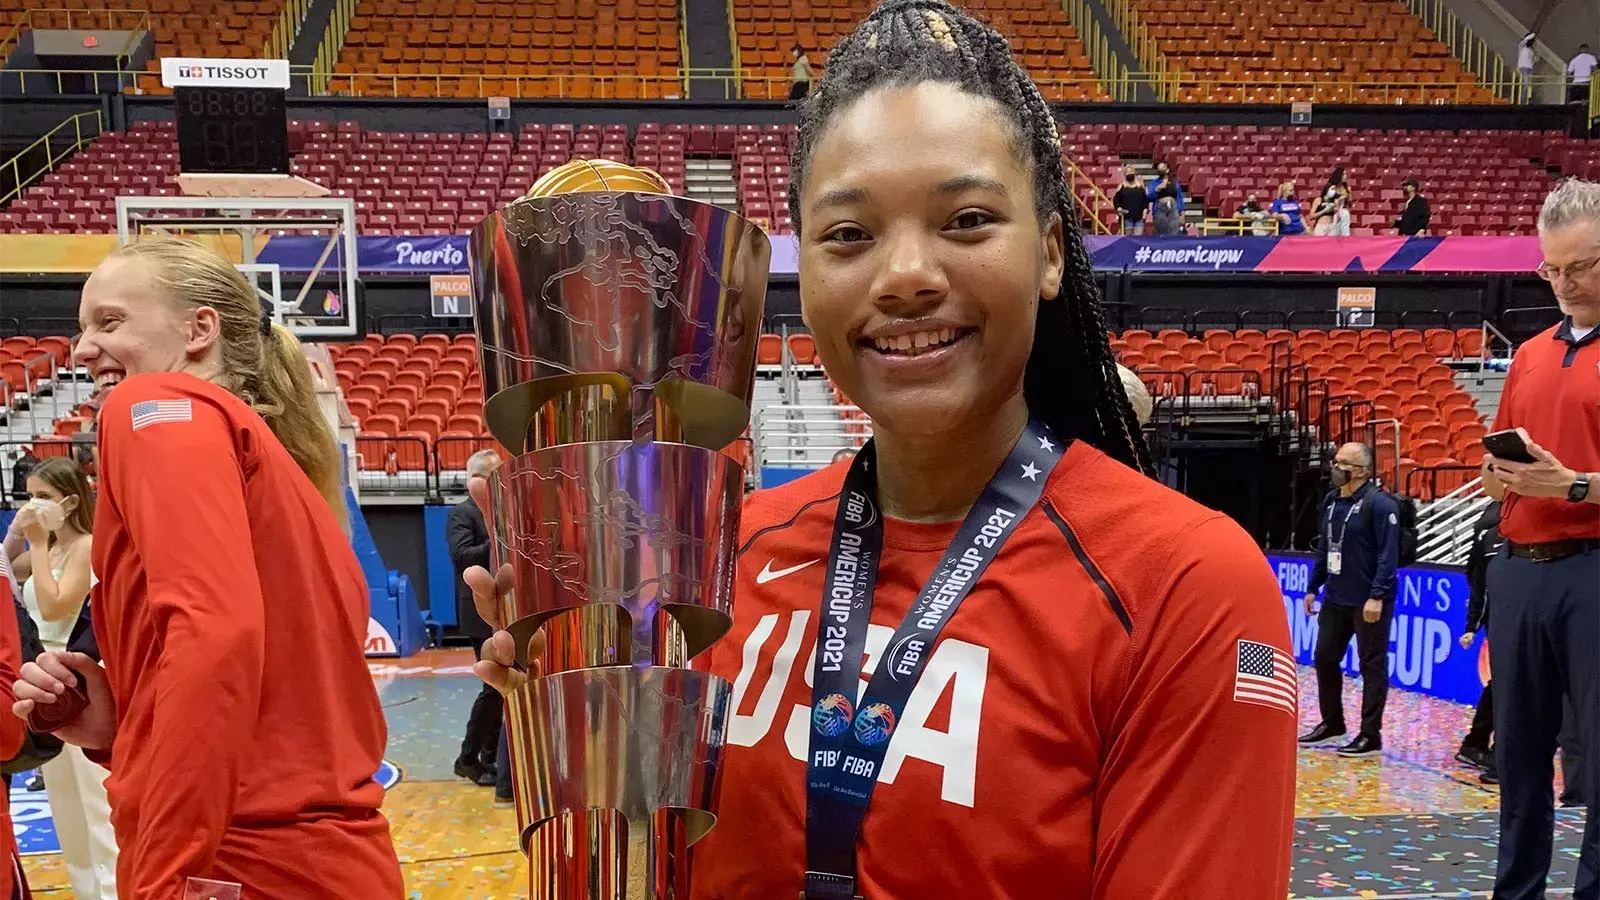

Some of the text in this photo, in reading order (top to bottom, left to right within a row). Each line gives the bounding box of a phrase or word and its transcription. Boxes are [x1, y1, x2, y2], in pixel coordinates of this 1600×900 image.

[205, 67, 268, 79] TISSOT
[396, 242, 463, 264] Puerto
[1135, 245, 1244, 270] #americupw
[434, 282, 468, 292] PALCO
[1341, 294, 1372, 303] PALCO
[443, 296, 459, 314] N
[1350, 307, 1362, 324] P
[845, 491, 865, 528] FIBA
[853, 551, 872, 609] WOMEN'S
[914, 557, 957, 614] WOMEN'S
[1278, 562, 1309, 593] FIBA
[822, 532, 862, 672] AMERICUP 2021
[896, 507, 1017, 676] FIBA AMERICUP 2021
[842, 755, 875, 778] FIBA
